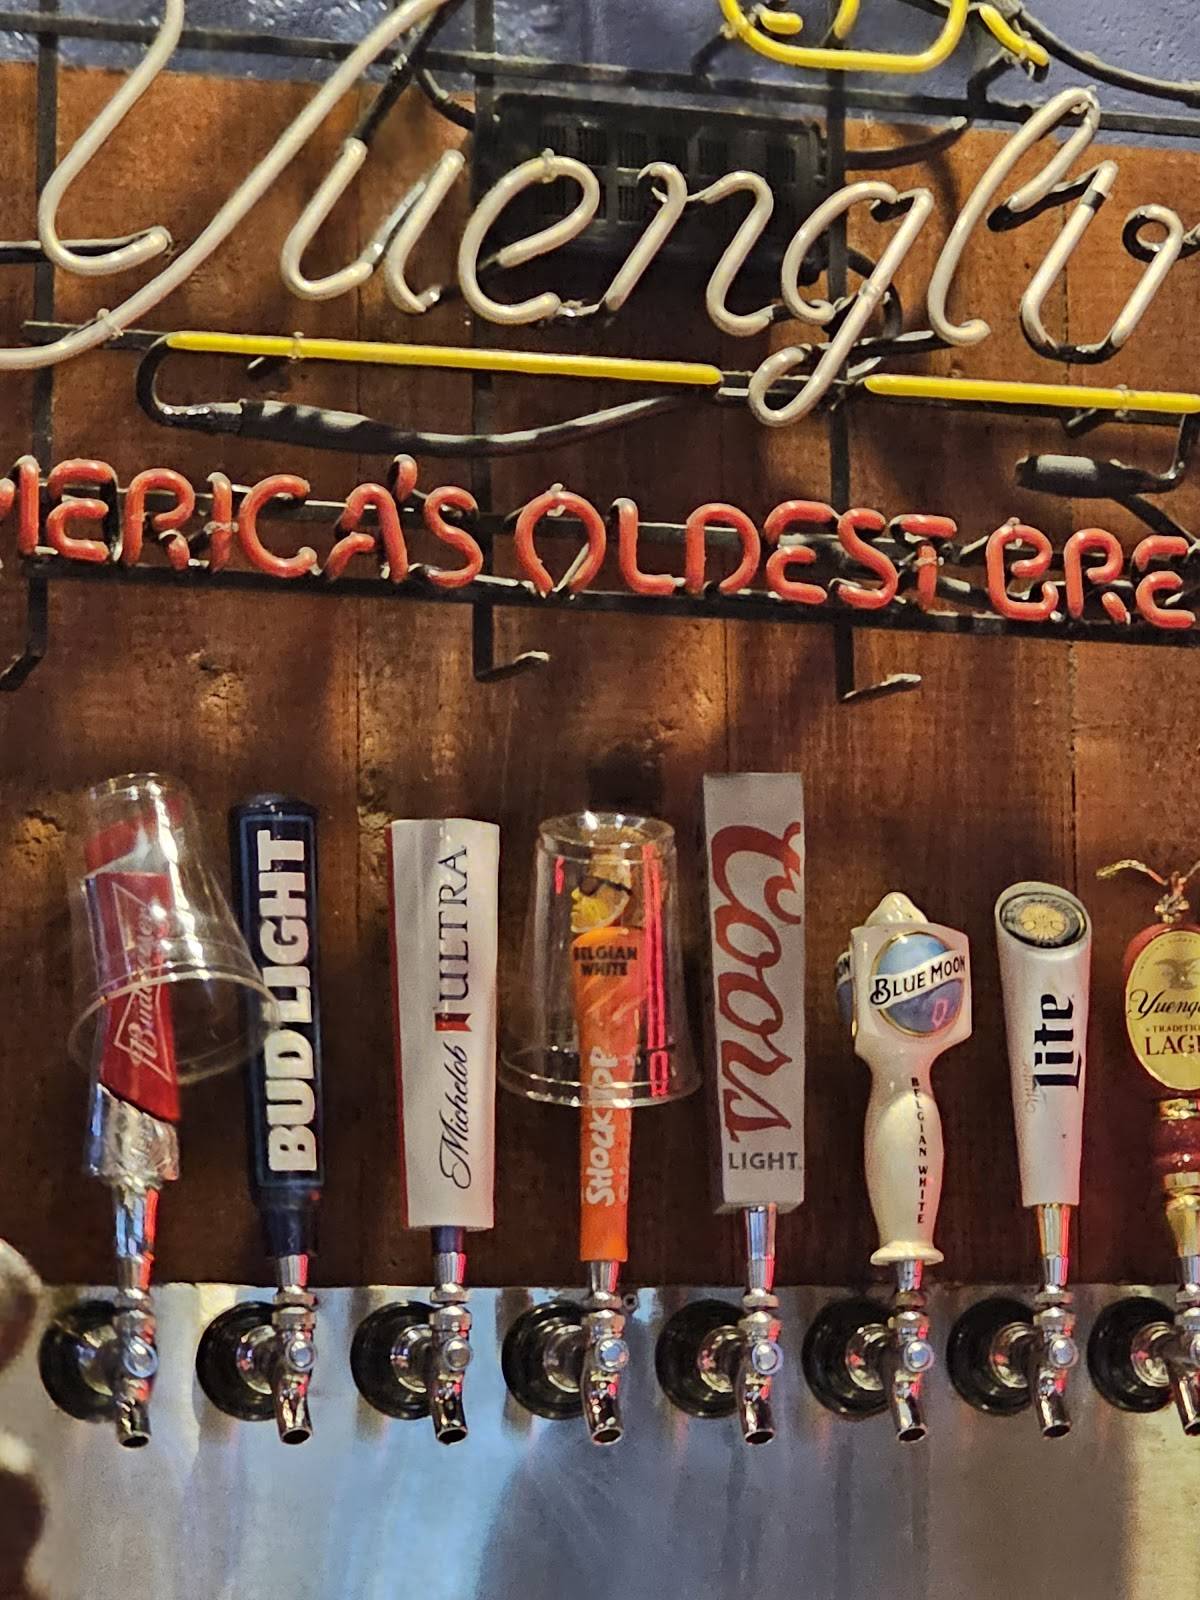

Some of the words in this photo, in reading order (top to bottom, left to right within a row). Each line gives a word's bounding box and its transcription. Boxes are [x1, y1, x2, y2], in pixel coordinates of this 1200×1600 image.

[514, 484, 957, 612] OLDEST
[985, 517, 1197, 630] BRE
[256, 829, 313, 1024] LIGHT
[438, 848, 469, 1002] ULTRA
[711, 821, 801, 1143] Coors
[869, 970, 926, 1006] BLUE
[930, 954, 967, 984] MOON
[1032, 993, 1082, 1092] Lite
[1128, 989, 1200, 1021] Yueng
[264, 1030, 318, 1172] BUD
[438, 1040, 472, 1190] Michelob
[728, 1151, 799, 1170] LIGHT
[911, 1077, 927, 1157] BELGIAN
[917, 1165, 928, 1225] WHITE
